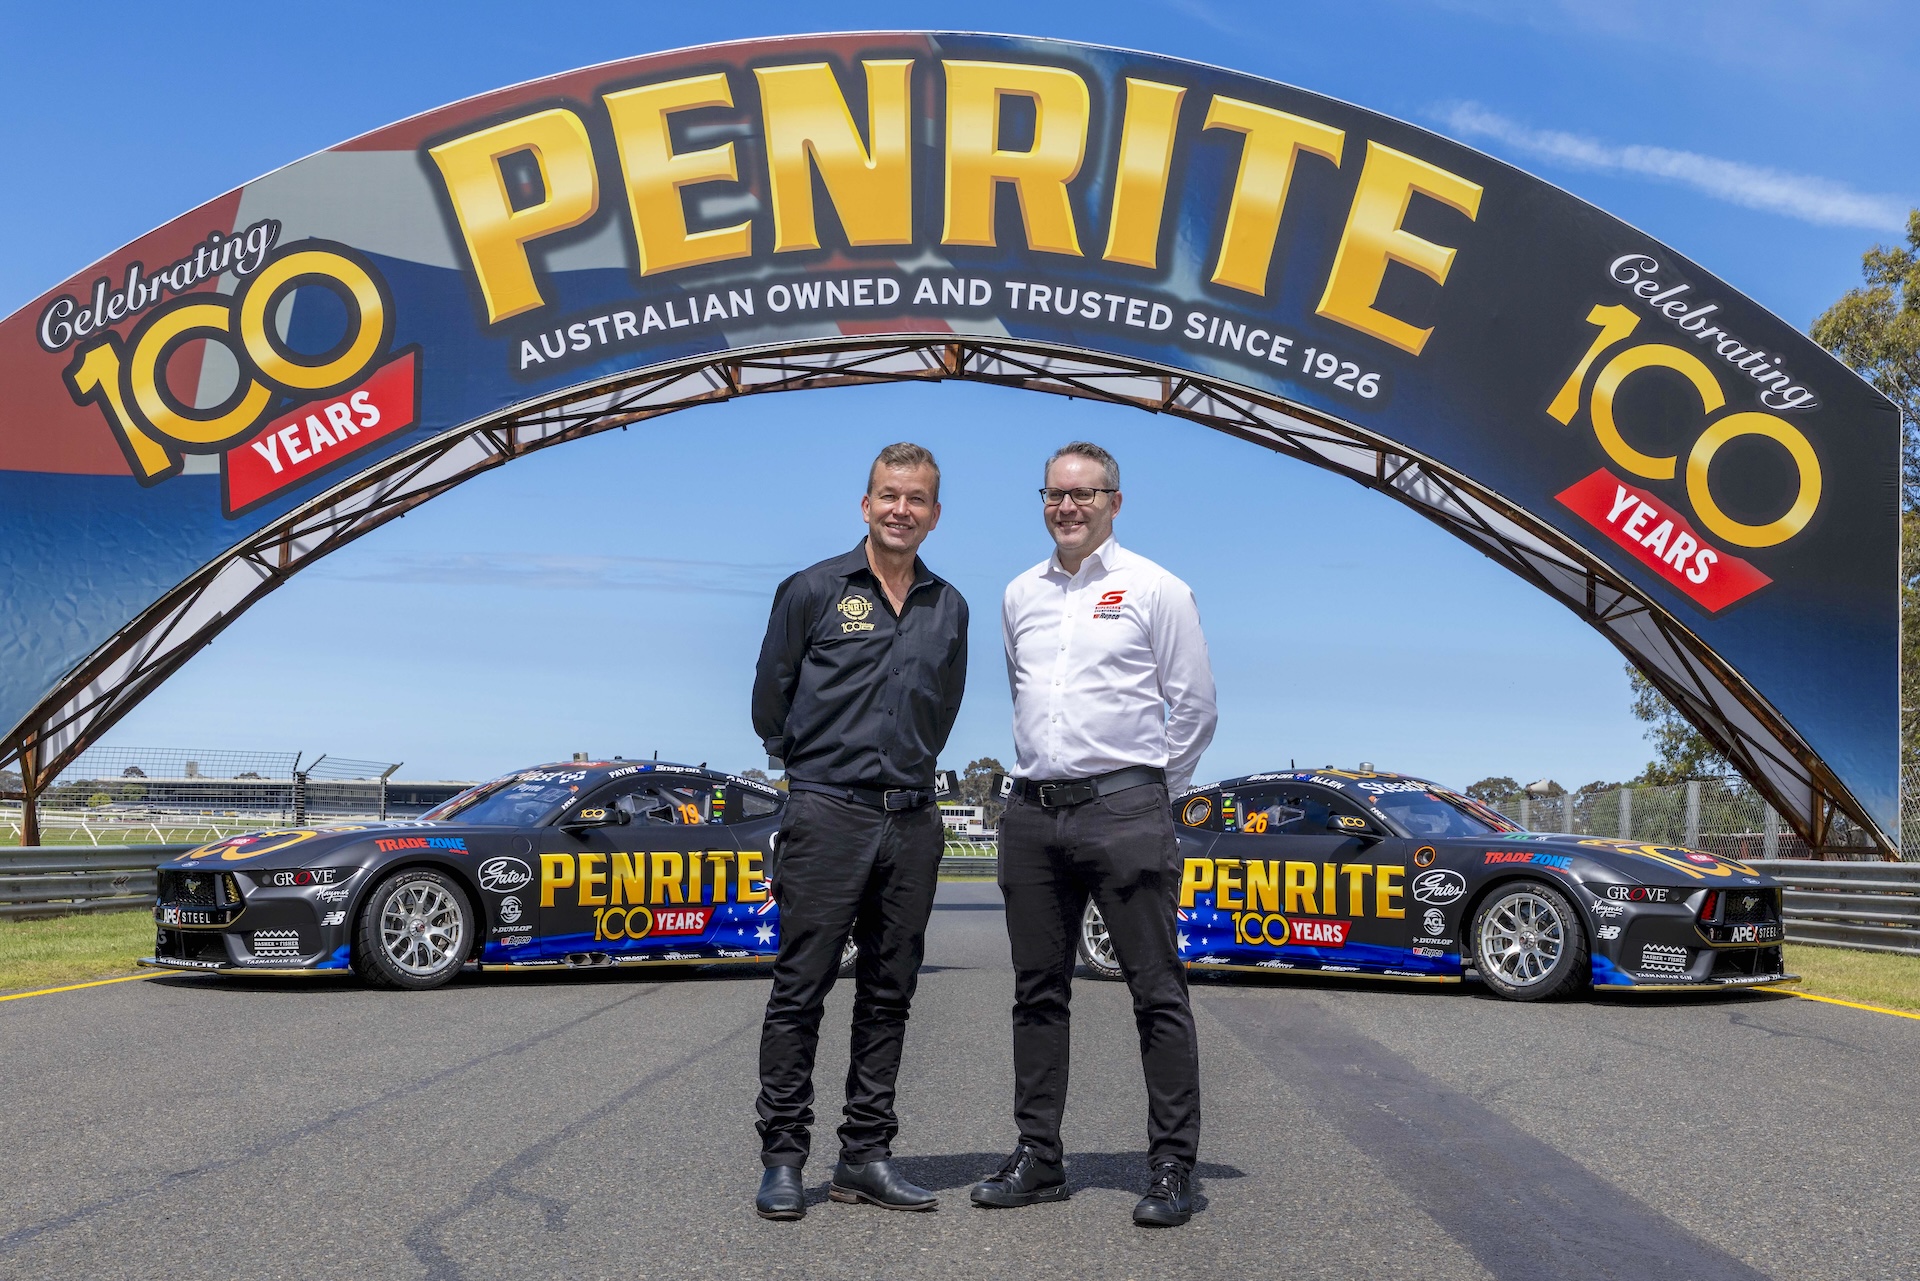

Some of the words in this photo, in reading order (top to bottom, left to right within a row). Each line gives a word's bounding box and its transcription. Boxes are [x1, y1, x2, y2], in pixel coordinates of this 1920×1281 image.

[428, 59, 1484, 356] PENRITE
[41, 222, 277, 349] Celebrating
[519, 288, 754, 369] AUSTRALIAN
[766, 278, 900, 313] OWNED
[913, 278, 992, 305] AND
[1005, 281, 1174, 331] TRUSTED
[1184, 312, 1294, 365] SINCE
[1301, 347, 1381, 399] 1926
[1609, 254, 1818, 410] Celebrating
[73, 250, 384, 478] 100
[252, 391, 381, 474] YEARS
[1546, 304, 1822, 548] 100
[1606, 484, 1719, 584] YEARS
[837, 602, 874, 612] PENRITE
[841, 621, 861, 634] 100
[608, 766, 639, 779] PAYNE
[655, 765, 701, 774] Snap-on
[1246, 773, 1294, 782] Snap-on
[736, 778, 778, 796] AUTODESK
[1178, 782, 1221, 798] AUTODESK
[1309, 776, 1345, 790] ALLEN
[580, 809, 605, 819] 100
[678, 803, 700, 825] 19
[1244, 812, 1269, 833] 26
[1340, 817, 1366, 828] 100
[375, 838, 467, 853] TRADEZONE
[1484, 852, 1573, 870] TRADEZONE
[274, 870, 334, 886] GROVE
[481, 861, 528, 889] Gates
[539, 851, 768, 907] PENRITE
[1179, 857, 1406, 919] PENRITE
[1414, 874, 1461, 901] Gates
[1607, 886, 1666, 902] GROVE
[163, 909, 182, 925] APEX
[182, 912, 211, 924] STEEL
[501, 905, 522, 914] ACL
[1591, 900, 1623, 918] Haymes
[498, 925, 532, 933] DUNLOP
[593, 906, 653, 941] 100
[657, 912, 704, 931] YEARS
[1231, 911, 1290, 945] 100
[1292, 922, 1343, 943] YEARS
[1424, 917, 1445, 926] ACL
[1419, 938, 1453, 946] DUNLOP
[1731, 926, 1758, 942] APEX
[1759, 927, 1777, 939] STEEL
[1421, 947, 1443, 957] Repco
